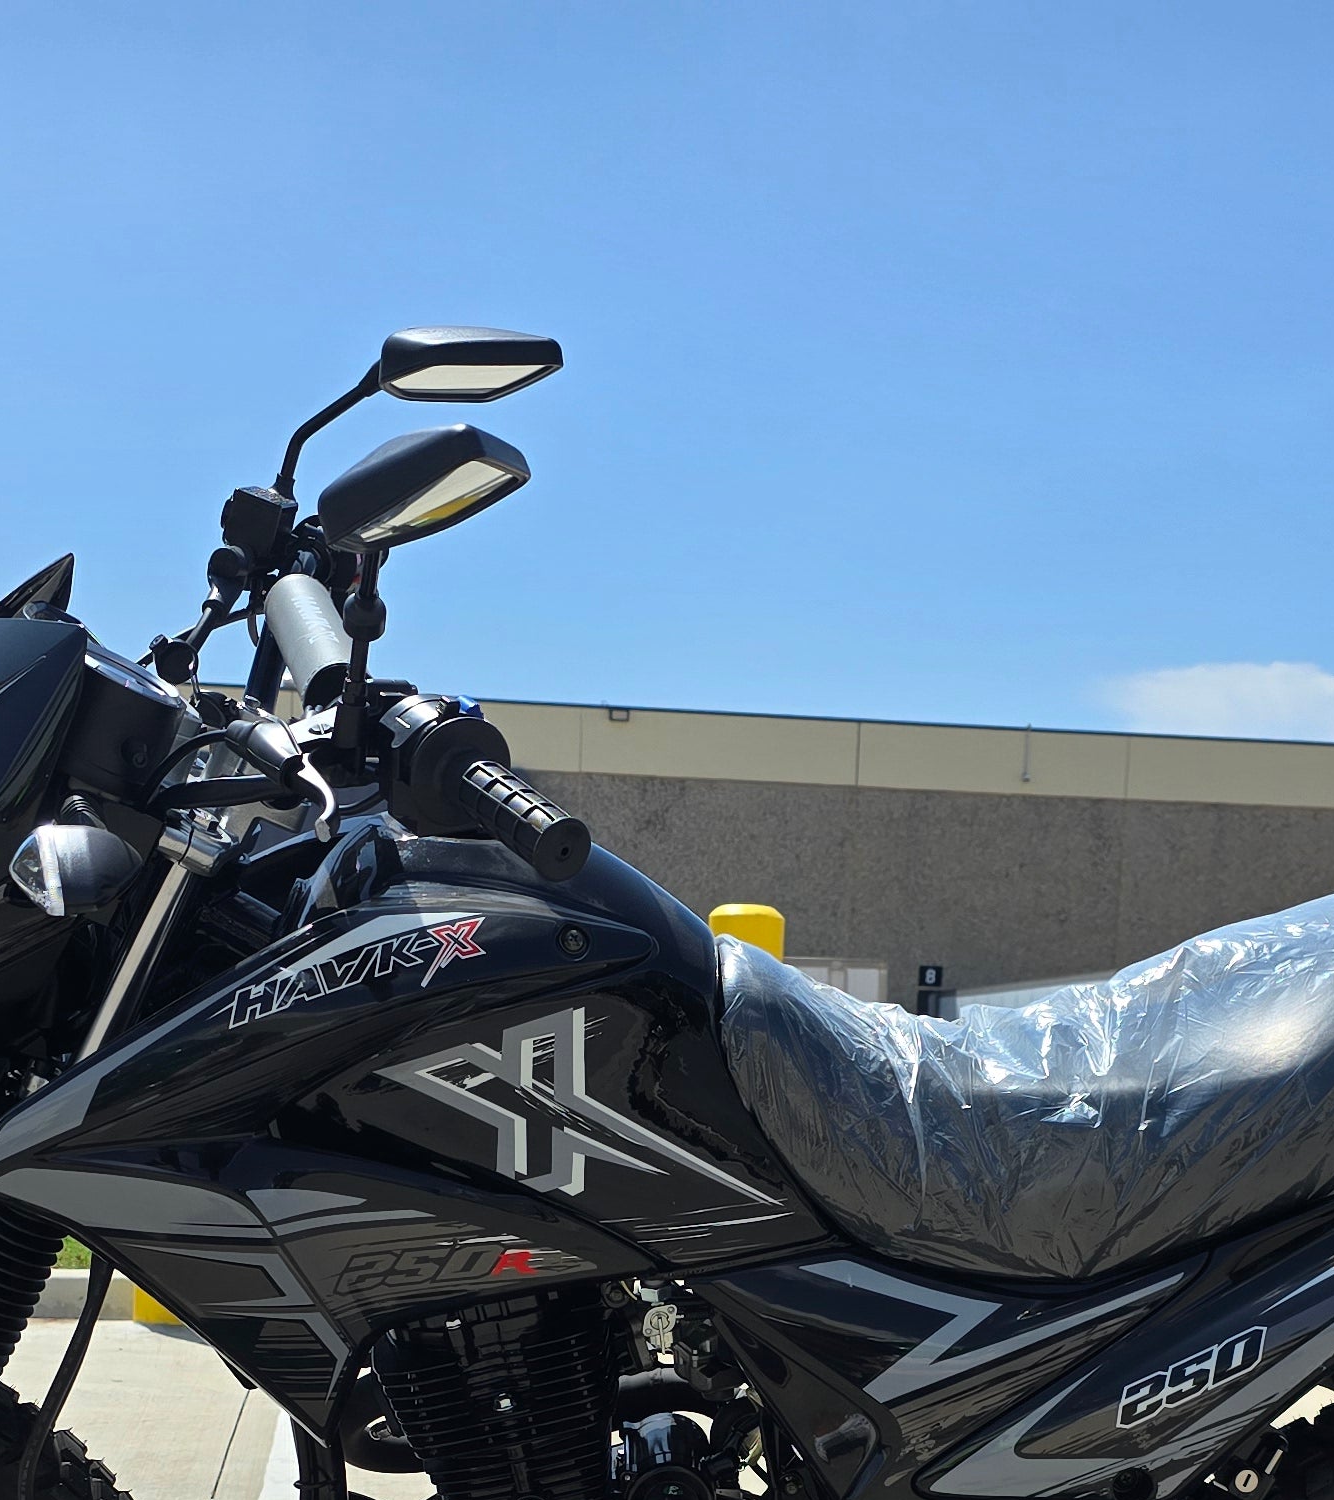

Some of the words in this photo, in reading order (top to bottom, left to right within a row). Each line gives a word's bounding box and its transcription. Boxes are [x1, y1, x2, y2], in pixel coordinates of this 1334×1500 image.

[228, 916, 487, 1029] HAWK-X
[924, 969, 937, 985] 8
[1115, 1325, 1267, 1429] 250
